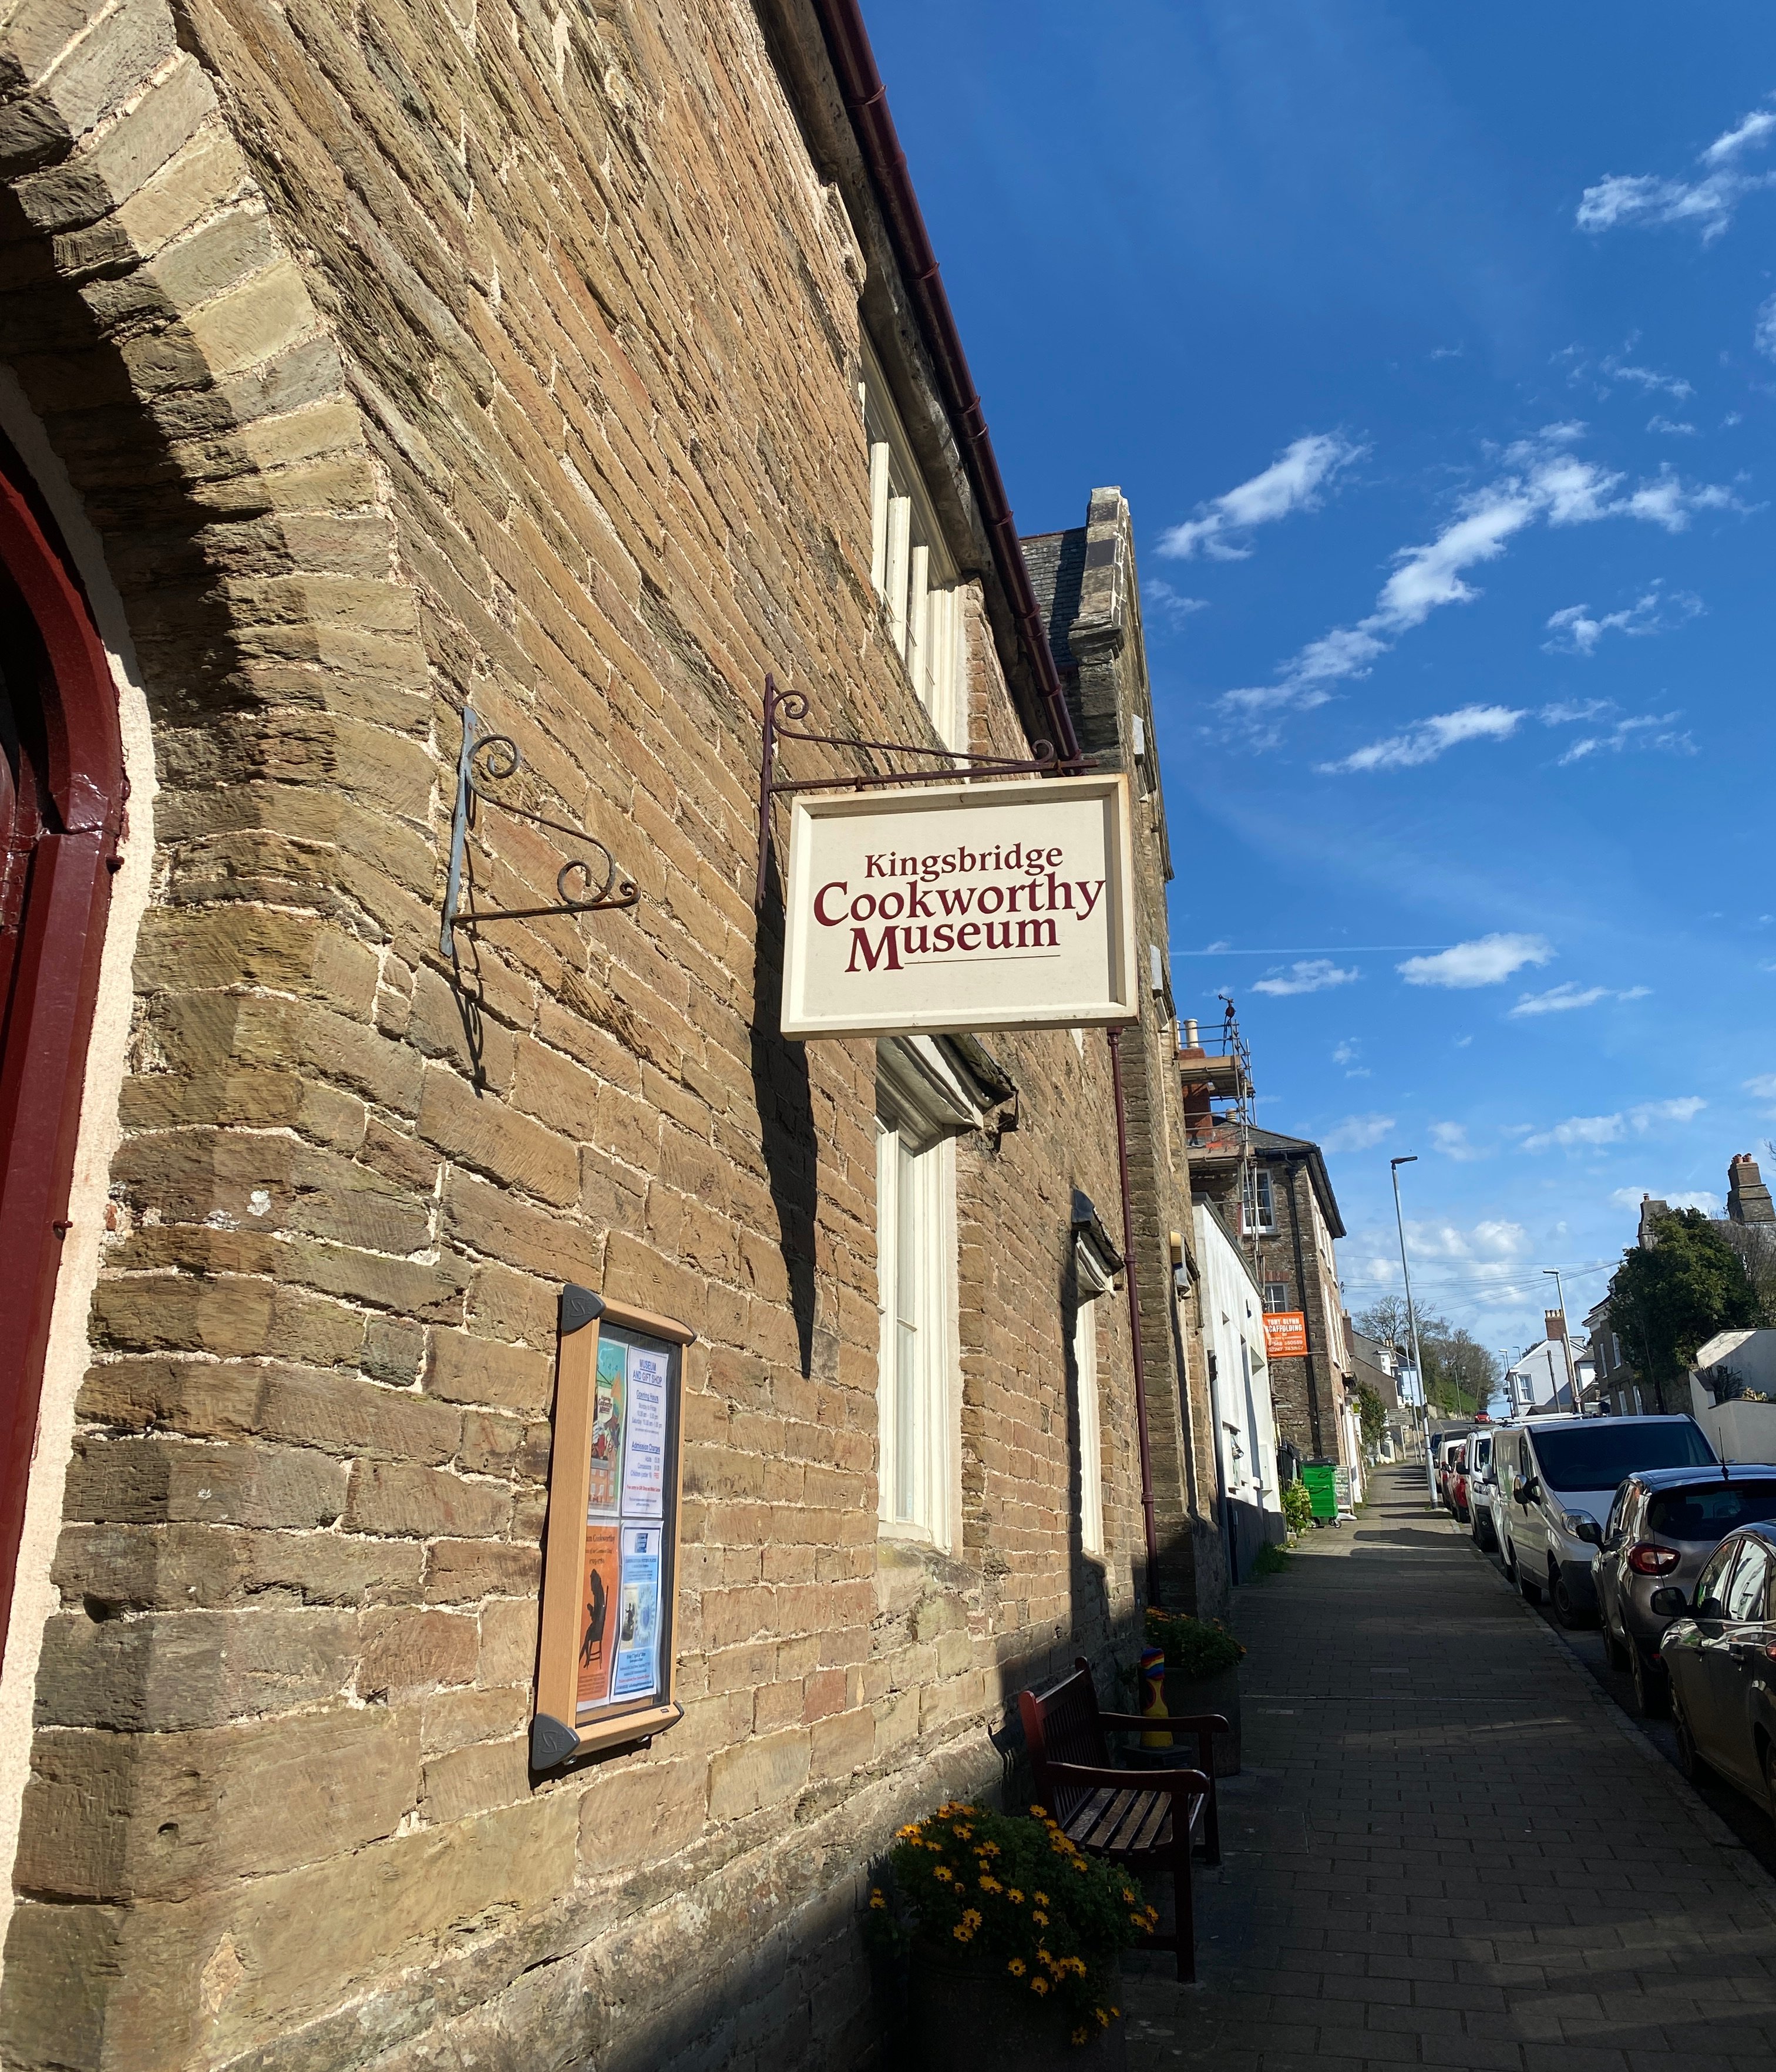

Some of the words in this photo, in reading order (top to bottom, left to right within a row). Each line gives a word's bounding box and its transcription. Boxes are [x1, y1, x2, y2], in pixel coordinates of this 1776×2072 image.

[865, 842, 1064, 882] Kingsbridge
[813, 872, 1106, 927] Cookworthy
[844, 918, 1061, 973] Museum
[640, 1359, 657, 1371] MUSEUM
[633, 1370, 641, 1380] AND
[643, 1372, 651, 1382] GIFT
[651, 1375, 662, 1385] SHOP
[636, 1390, 650, 1401] Opening
[631, 1441, 648, 1451] Admission
[649, 1444, 660, 1453] Charges
[593, 1533, 615, 1544] Cookworthy
